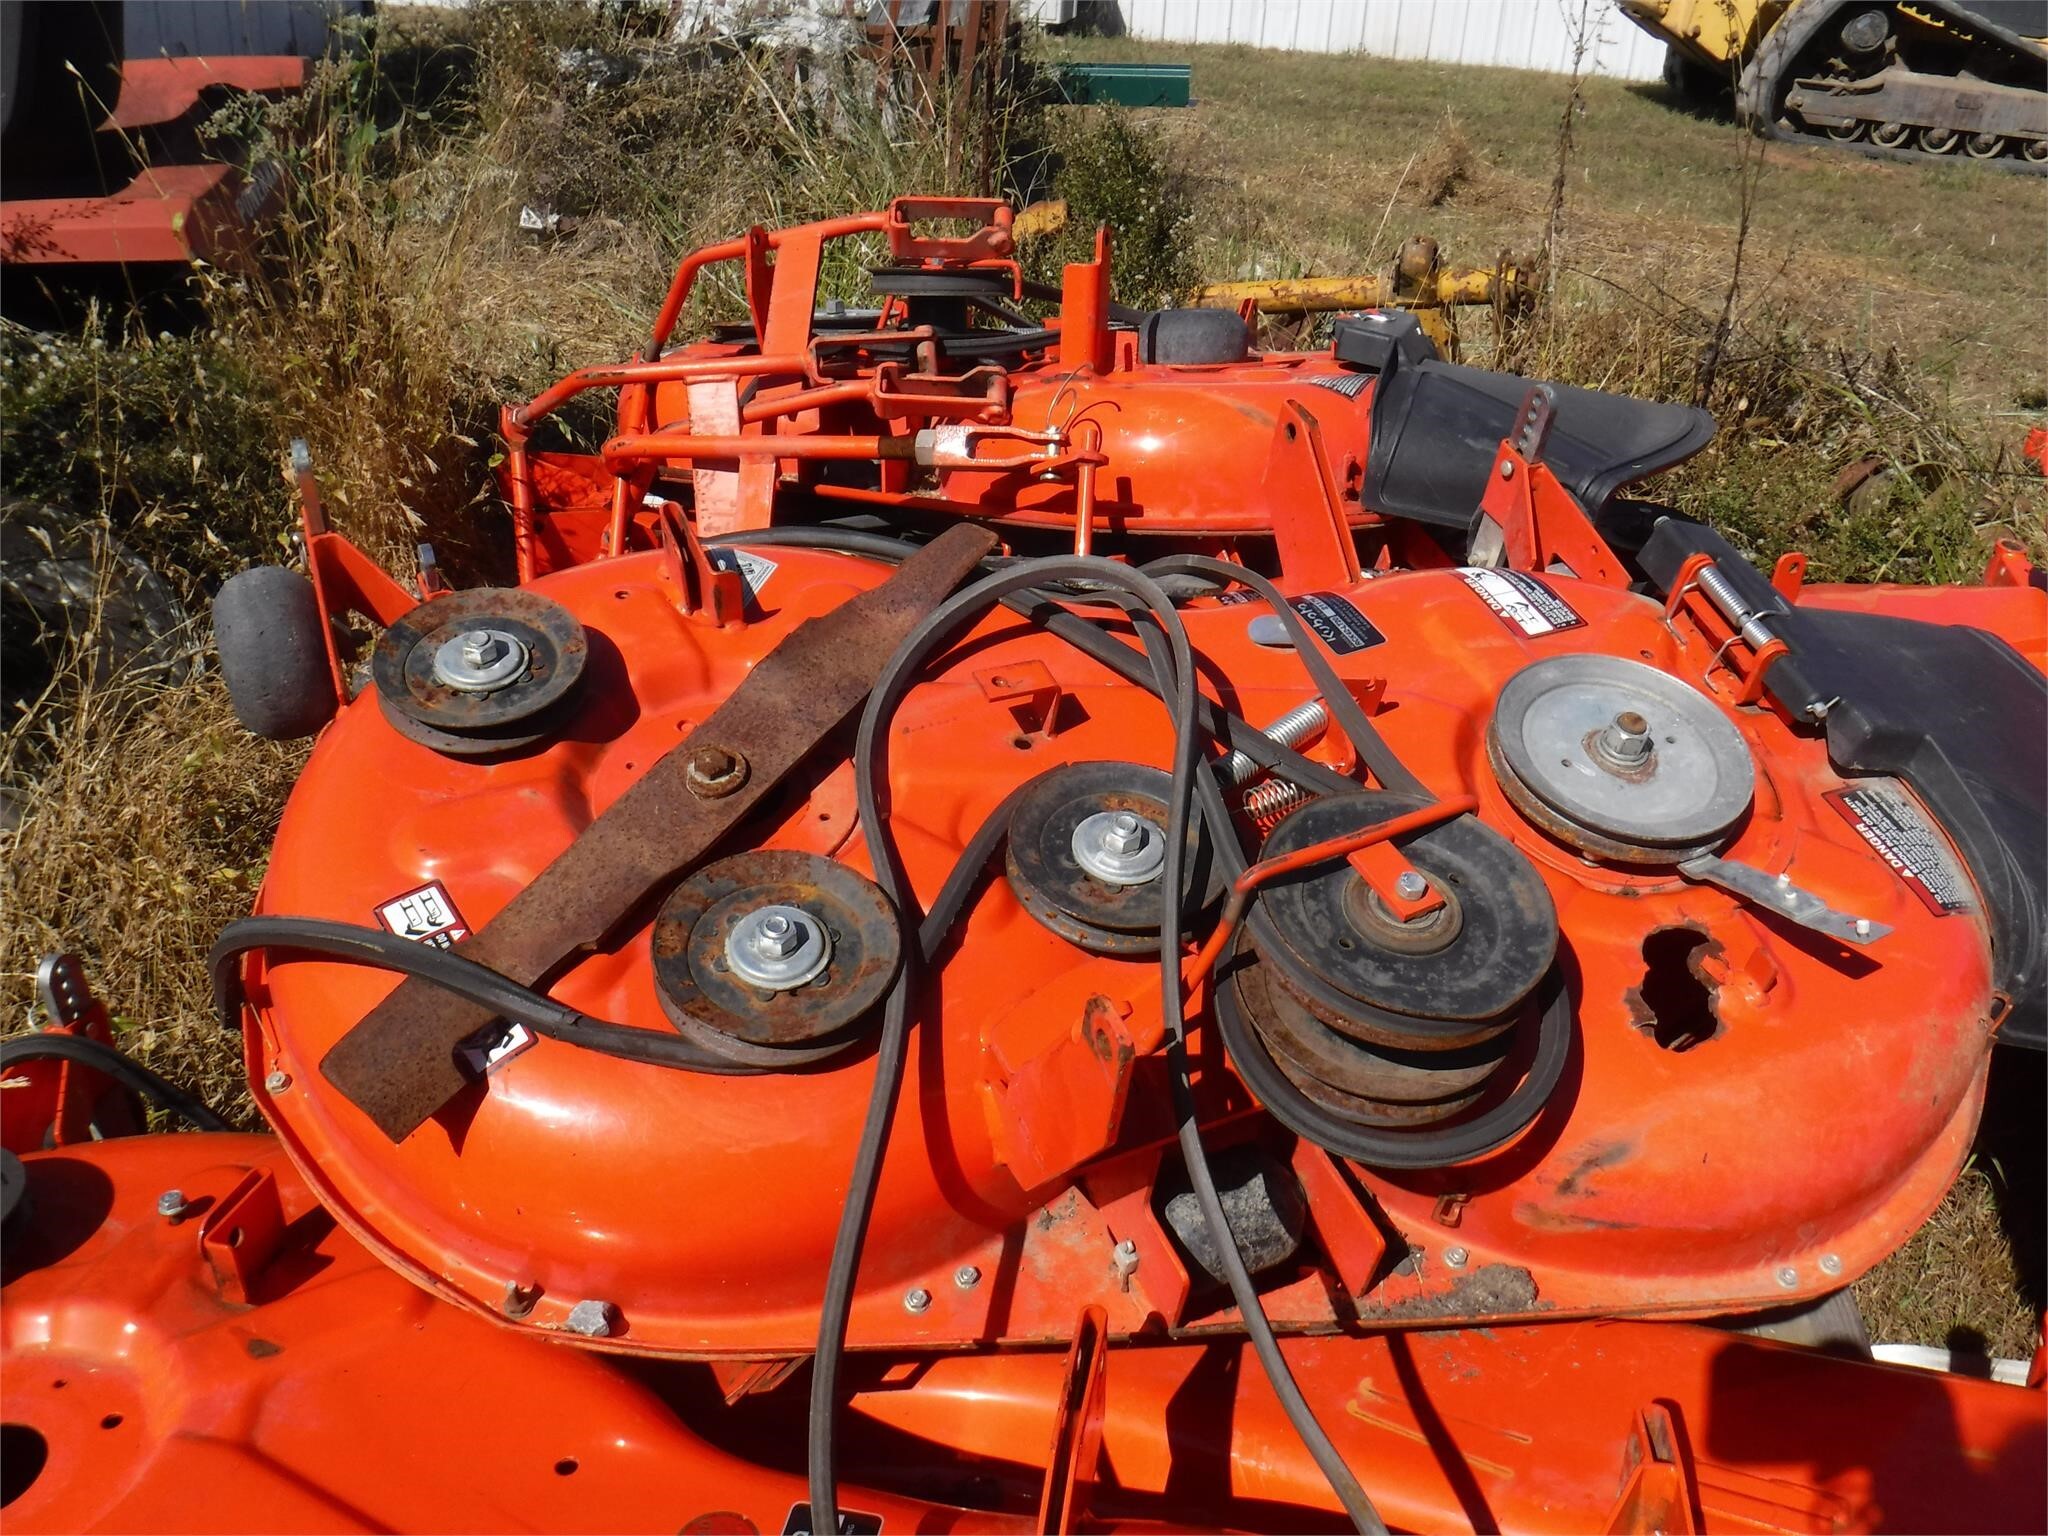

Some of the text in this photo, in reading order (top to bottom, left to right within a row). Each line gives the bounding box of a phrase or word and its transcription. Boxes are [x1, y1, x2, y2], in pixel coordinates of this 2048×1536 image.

[1463, 578, 1502, 611] DANGER
[1298, 603, 1336, 642] Kubota
[1843, 797, 1864, 816] DEATH
[1856, 823, 1904, 868] DANGER
[1871, 826, 1895, 848] INJURY
[1892, 846, 1920, 874] SERIOUS
[1917, 873, 1937, 894] AVOID
